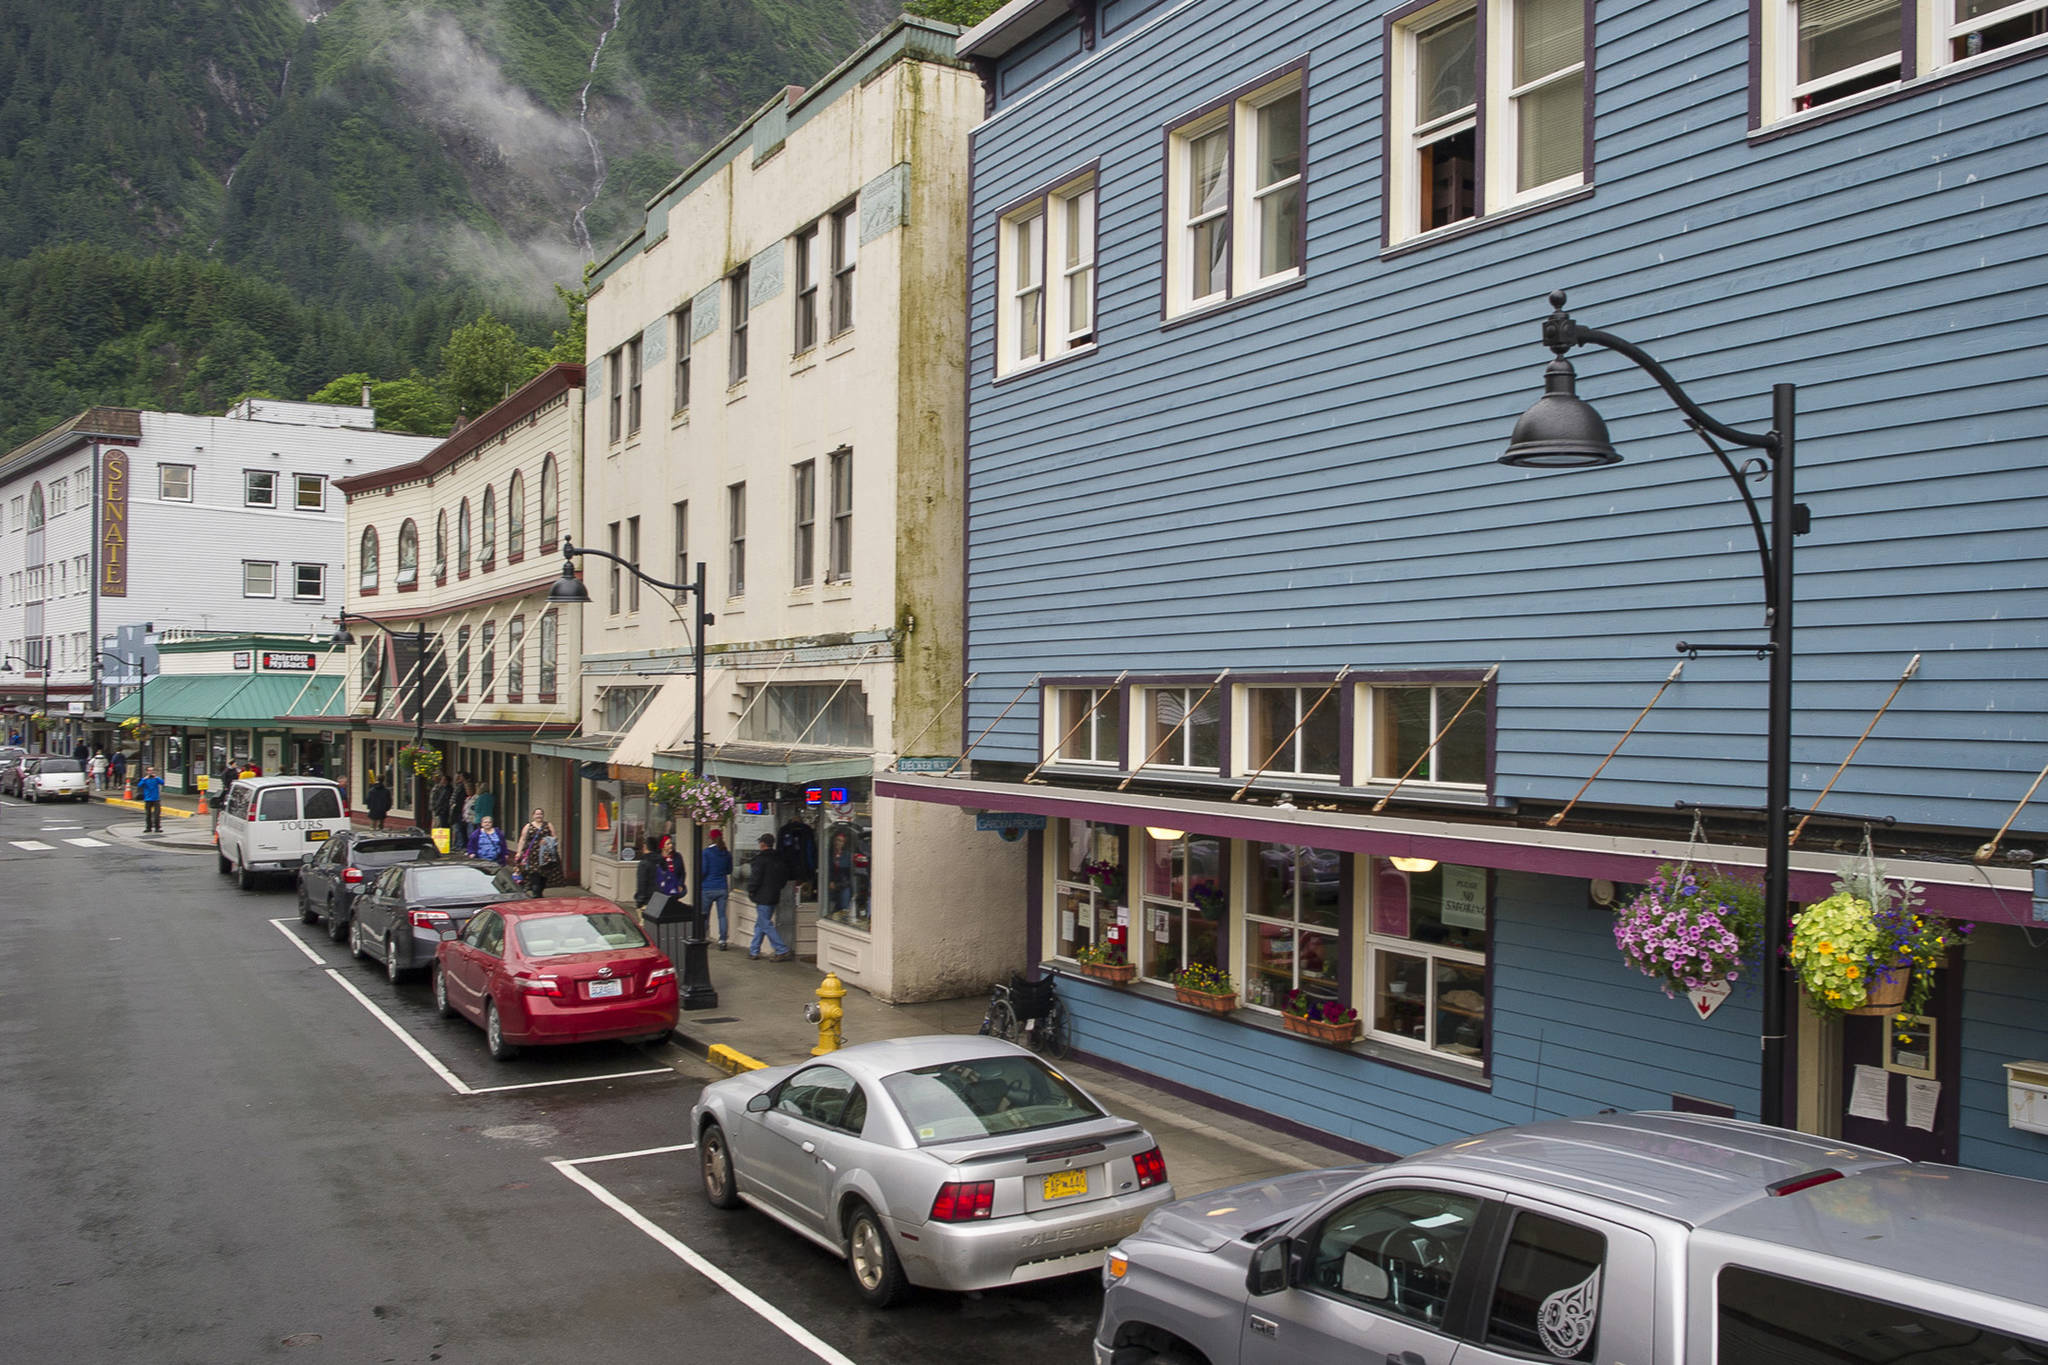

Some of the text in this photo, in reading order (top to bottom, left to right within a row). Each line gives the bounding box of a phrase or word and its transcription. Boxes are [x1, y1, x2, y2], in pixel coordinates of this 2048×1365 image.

[104, 460, 126, 584] SENATE
[279, 820, 324, 831] TOURS
[1021, 1215, 1137, 1248] MUSTANG
